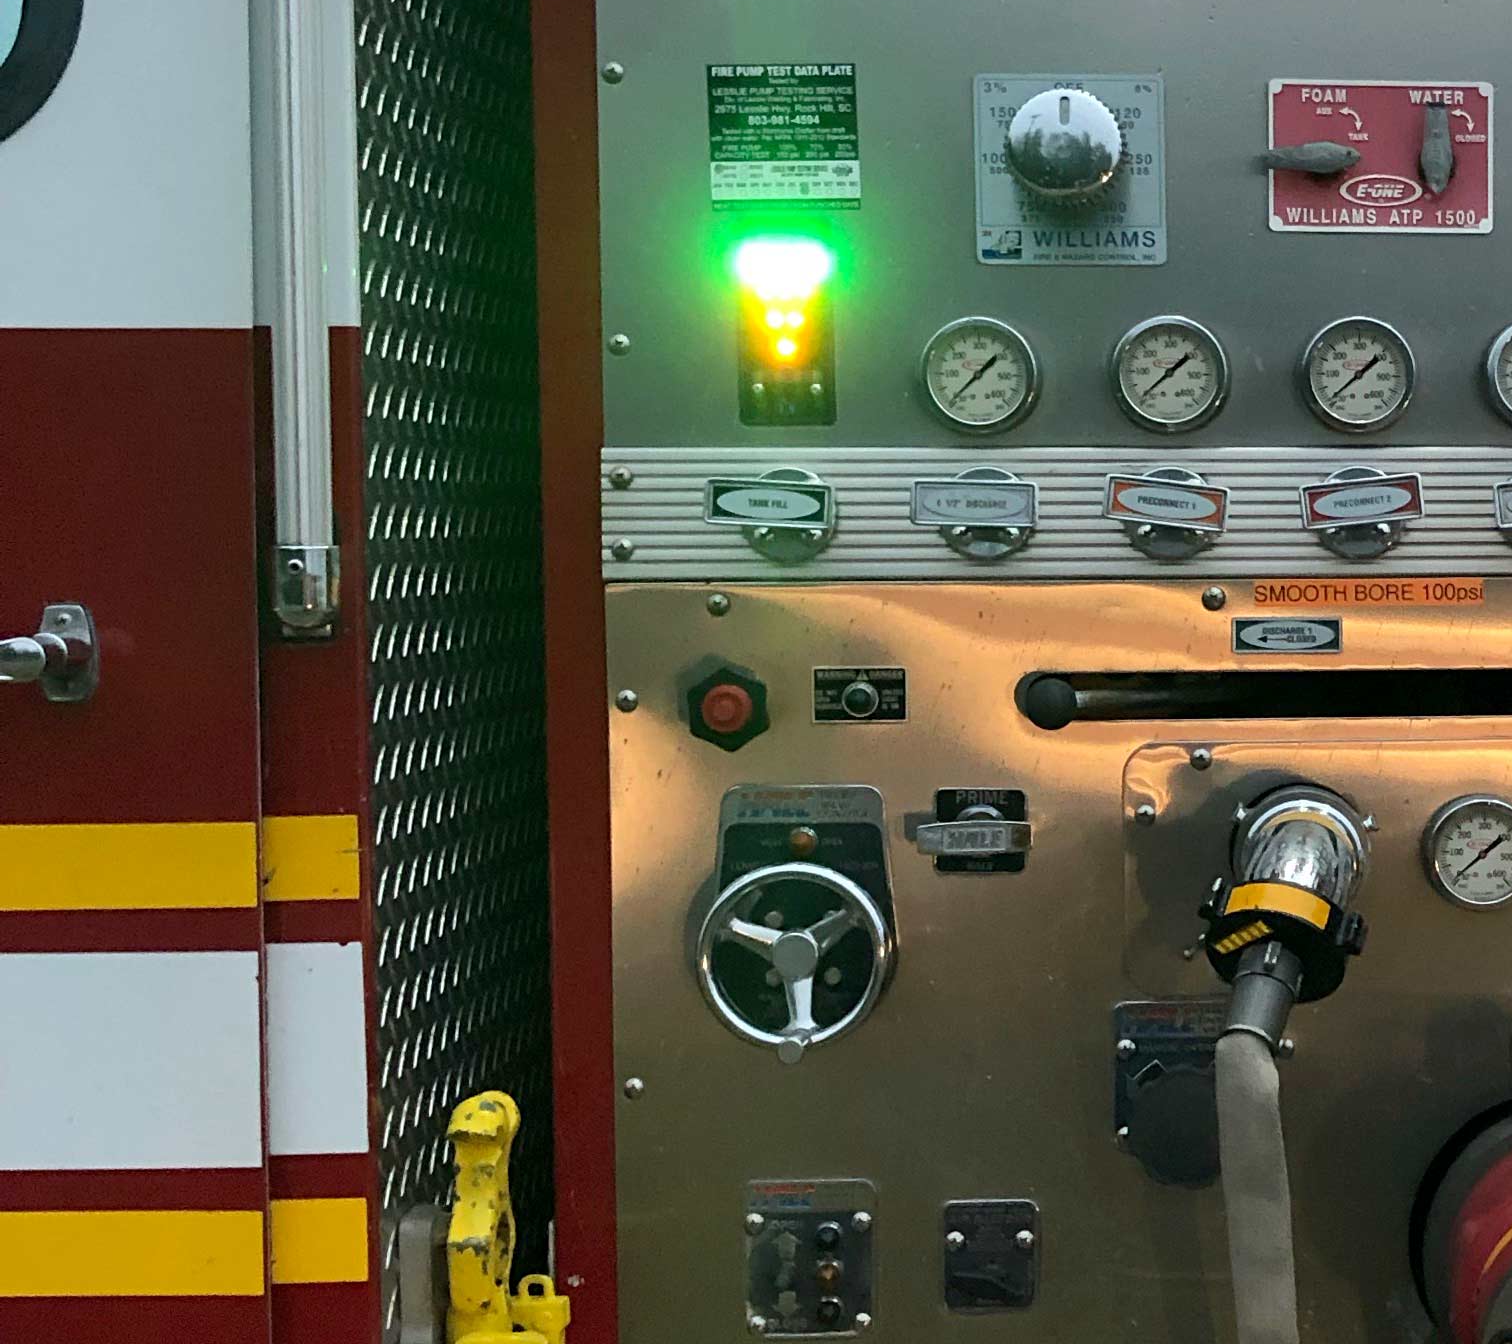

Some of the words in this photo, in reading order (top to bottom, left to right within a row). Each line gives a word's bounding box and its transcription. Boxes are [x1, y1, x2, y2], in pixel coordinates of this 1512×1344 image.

[712, 67, 733, 77] FIRE
[736, 66, 764, 76] PUMP
[767, 66, 792, 76] TEST
[795, 66, 819, 76] DATA
[822, 66, 852, 76] PLATE
[983, 82, 1007, 93] 3%
[1301, 88, 1347, 103] FOAM
[1409, 90, 1464, 105] WATER
[1287, 208, 1377, 224] WILLIAMS
[1389, 209, 1423, 224] ATP
[1436, 210, 1476, 225] 1500
[1034, 230, 1156, 248] WILLIAMS
[1137, 495, 1189, 510] PRECONNECT
[1333, 496, 1383, 509] PRECONNECT
[1255, 585, 1348, 602] SMOOTH
[1354, 584, 1414, 601] BORE
[1422, 584, 1483, 602] 100psi
[955, 790, 1008, 805] PRIME
